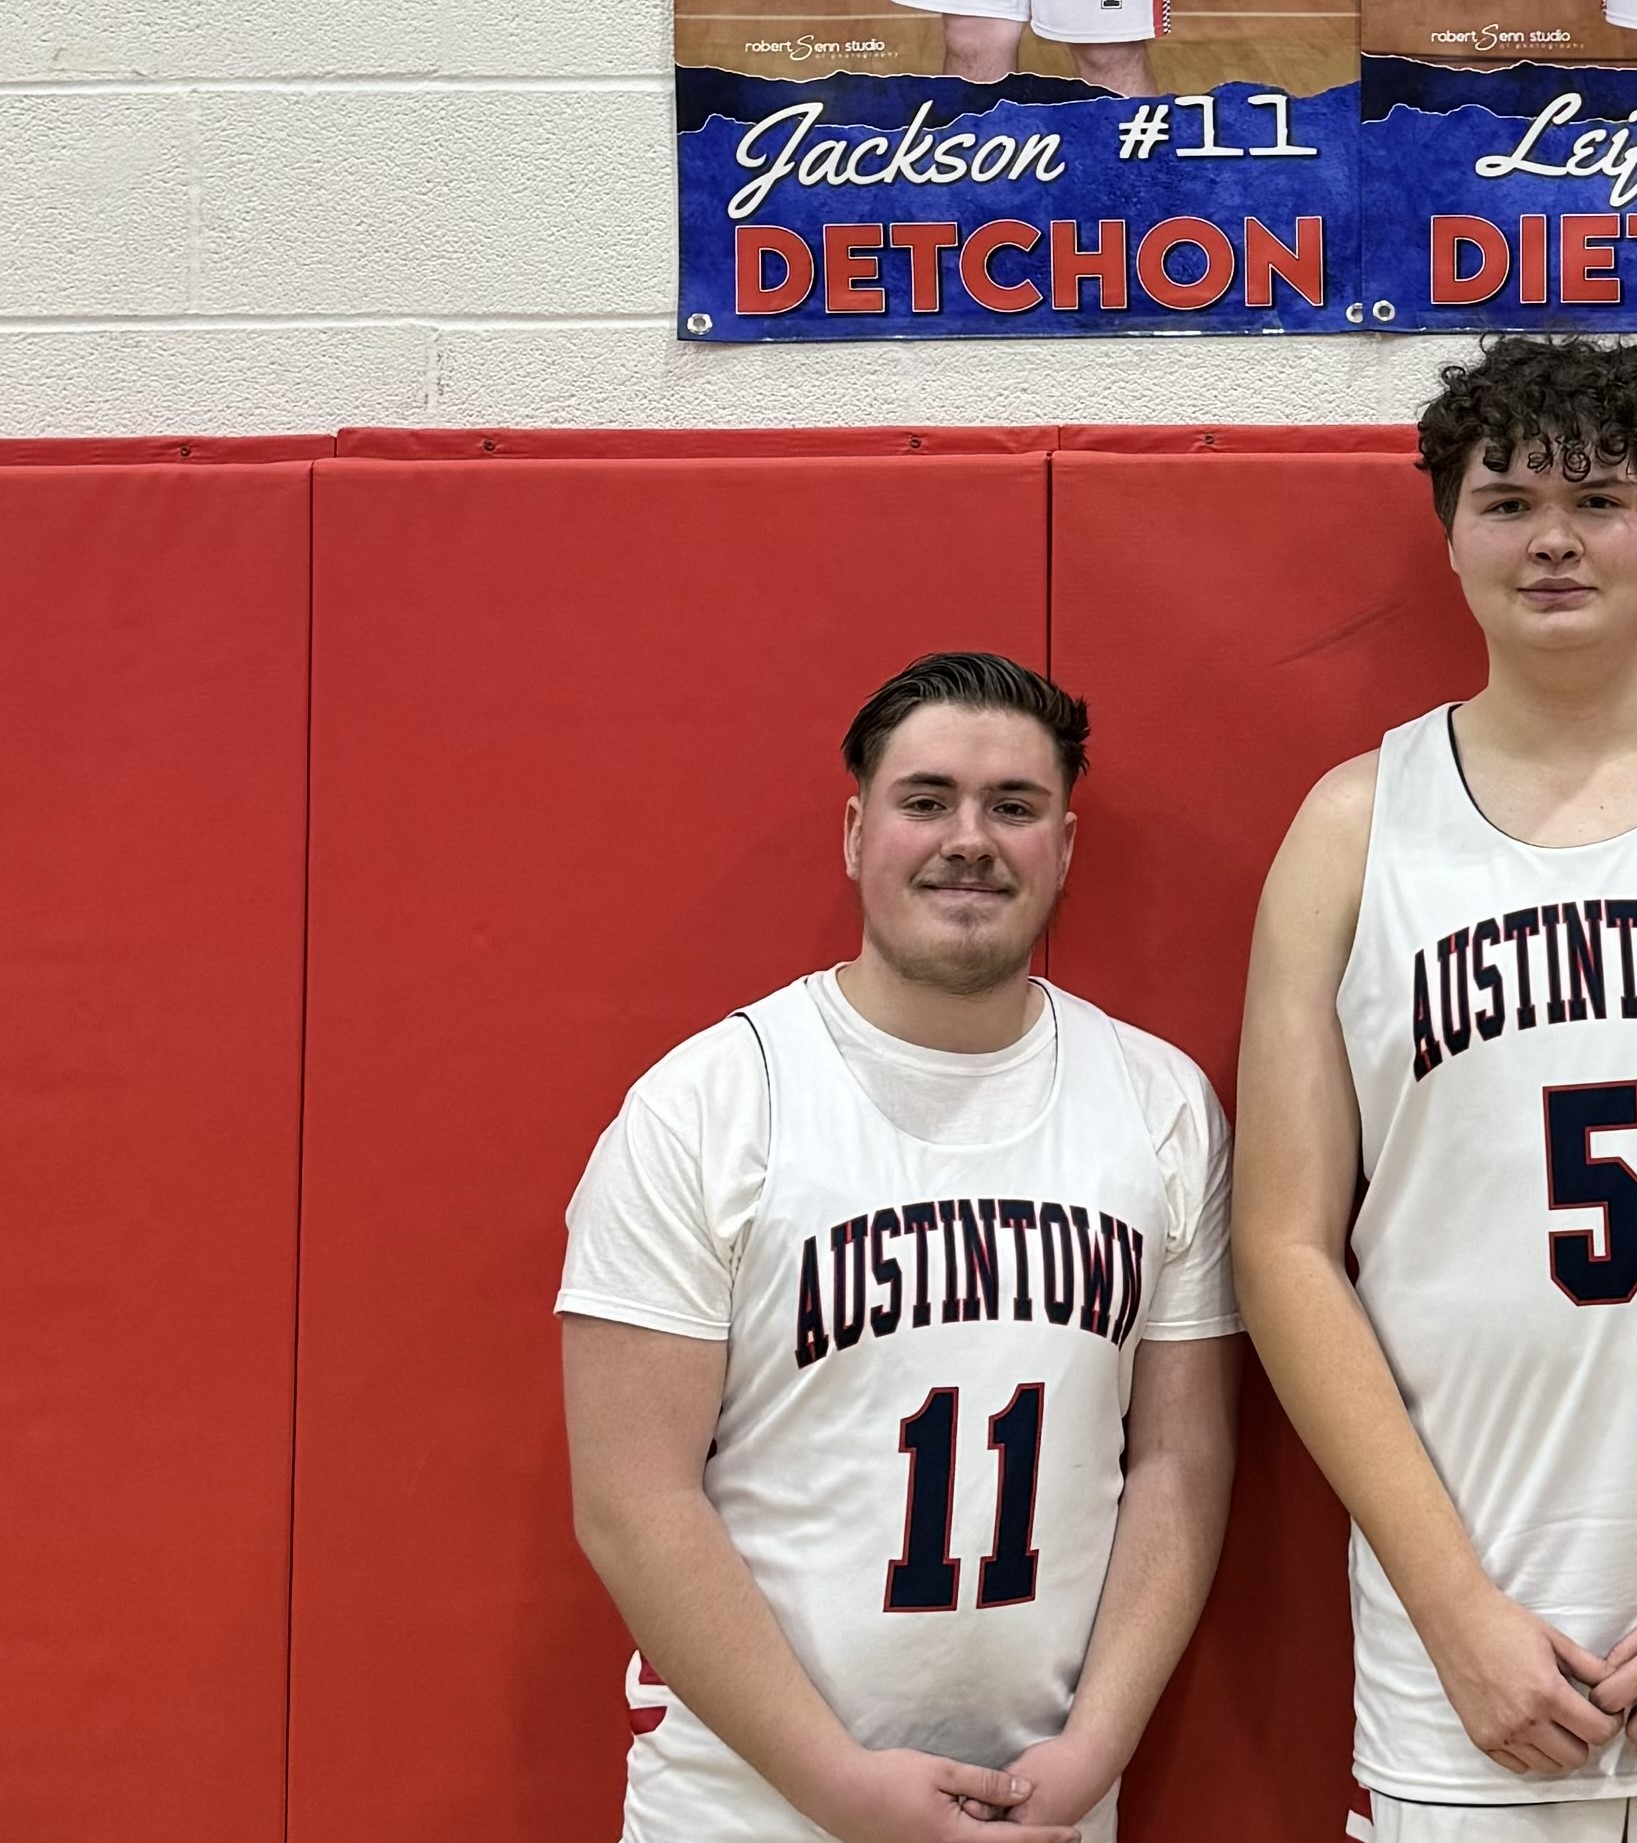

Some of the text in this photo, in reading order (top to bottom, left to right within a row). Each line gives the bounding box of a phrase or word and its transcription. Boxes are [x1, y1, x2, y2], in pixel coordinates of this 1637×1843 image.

[744, 39, 793, 52] robert
[845, 38, 886, 52] studio
[1430, 30, 1478, 43] robert
[1529, 29, 1571, 42] studio
[727, 95, 1318, 220] Jackson #11
[734, 215, 1324, 315] DETCHON
[794, 1198, 1144, 1370] AUSTINTOWN
[882, 1382, 1046, 1613] 11
